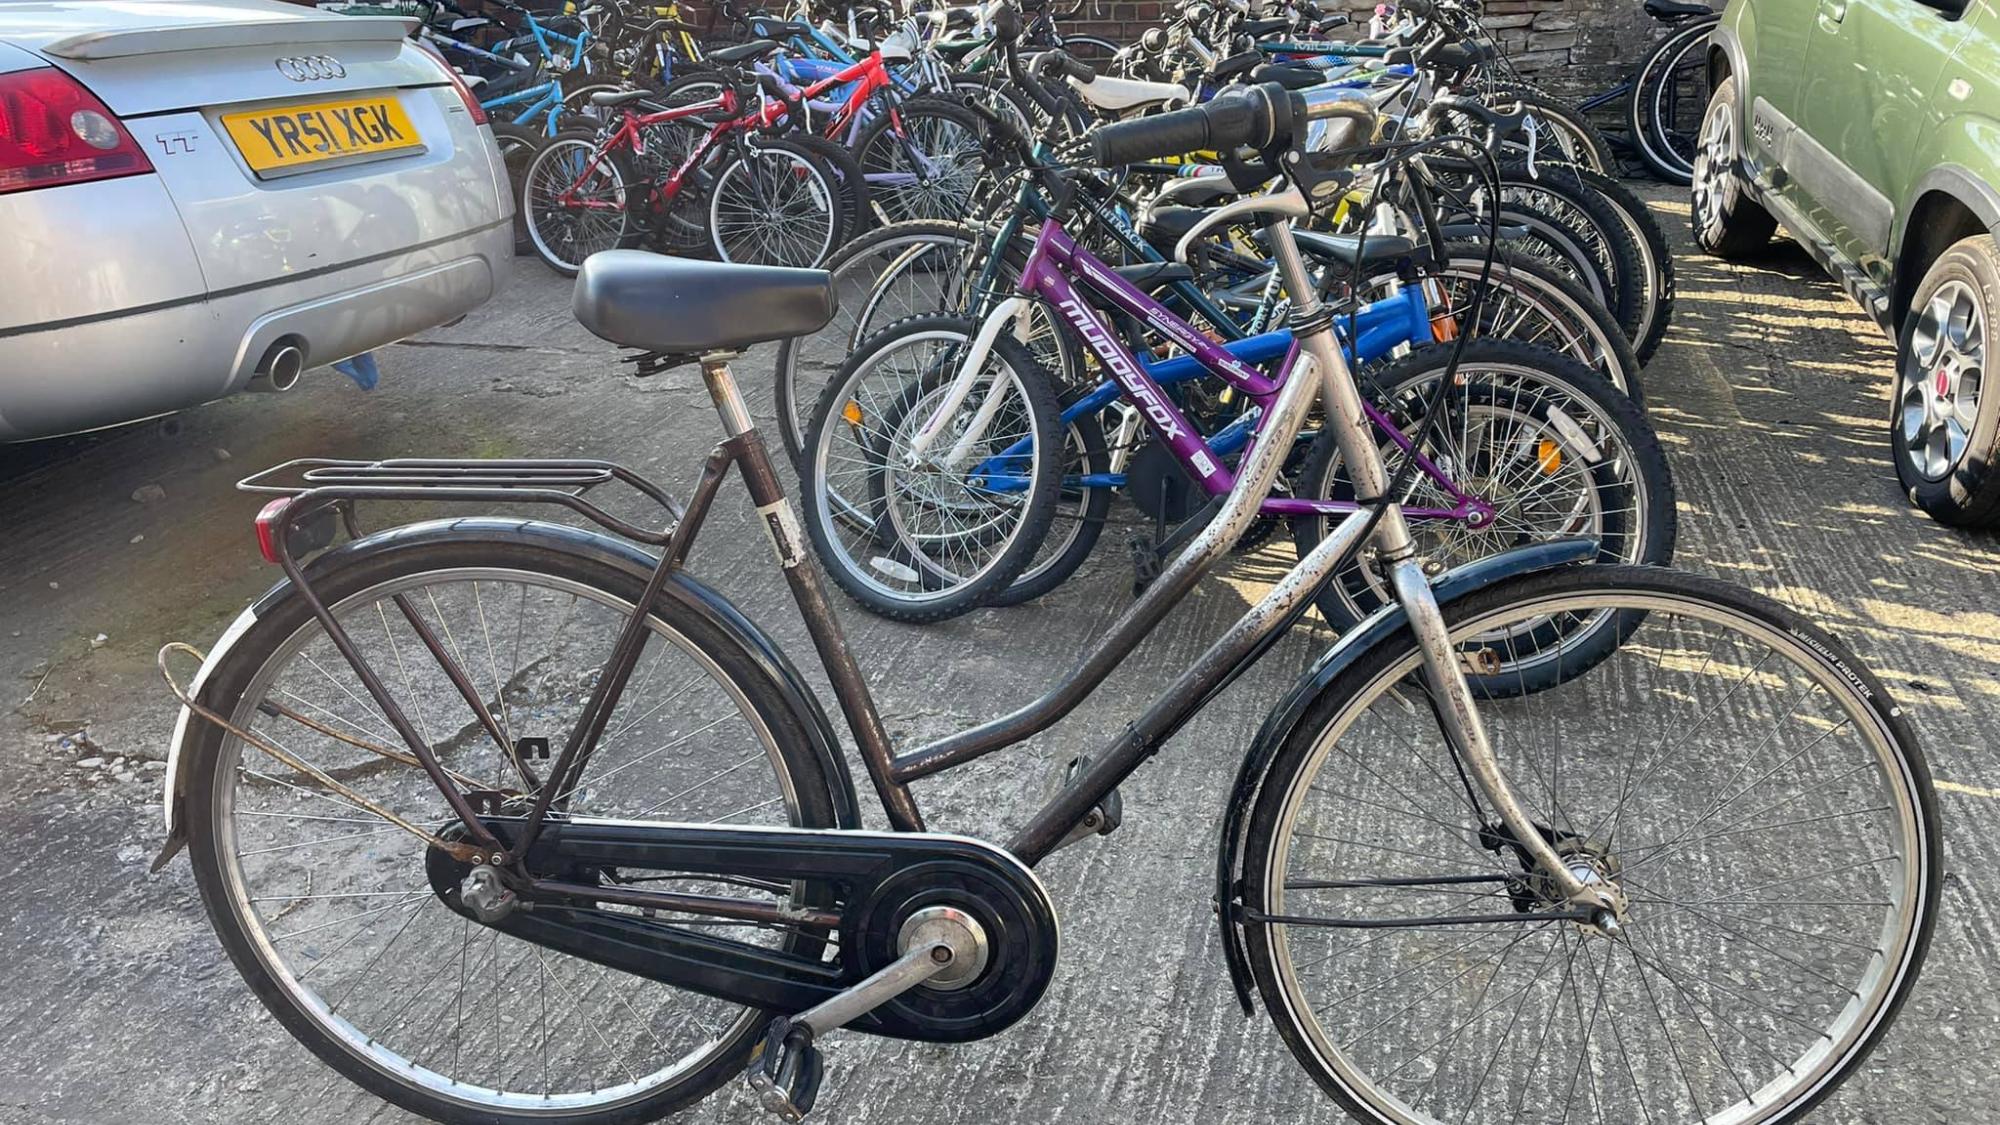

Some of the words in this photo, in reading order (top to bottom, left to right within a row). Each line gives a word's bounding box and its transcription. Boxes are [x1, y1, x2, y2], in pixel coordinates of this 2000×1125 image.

[155, 129, 198, 155] TT
[249, 112, 341, 158] YR51
[333, 104, 403, 147] XGK
[1059, 300, 1186, 440] MUDDYFOX
[1797, 632, 1839, 662] MICHELIN
[1835, 660, 1874, 699] PROTEK
